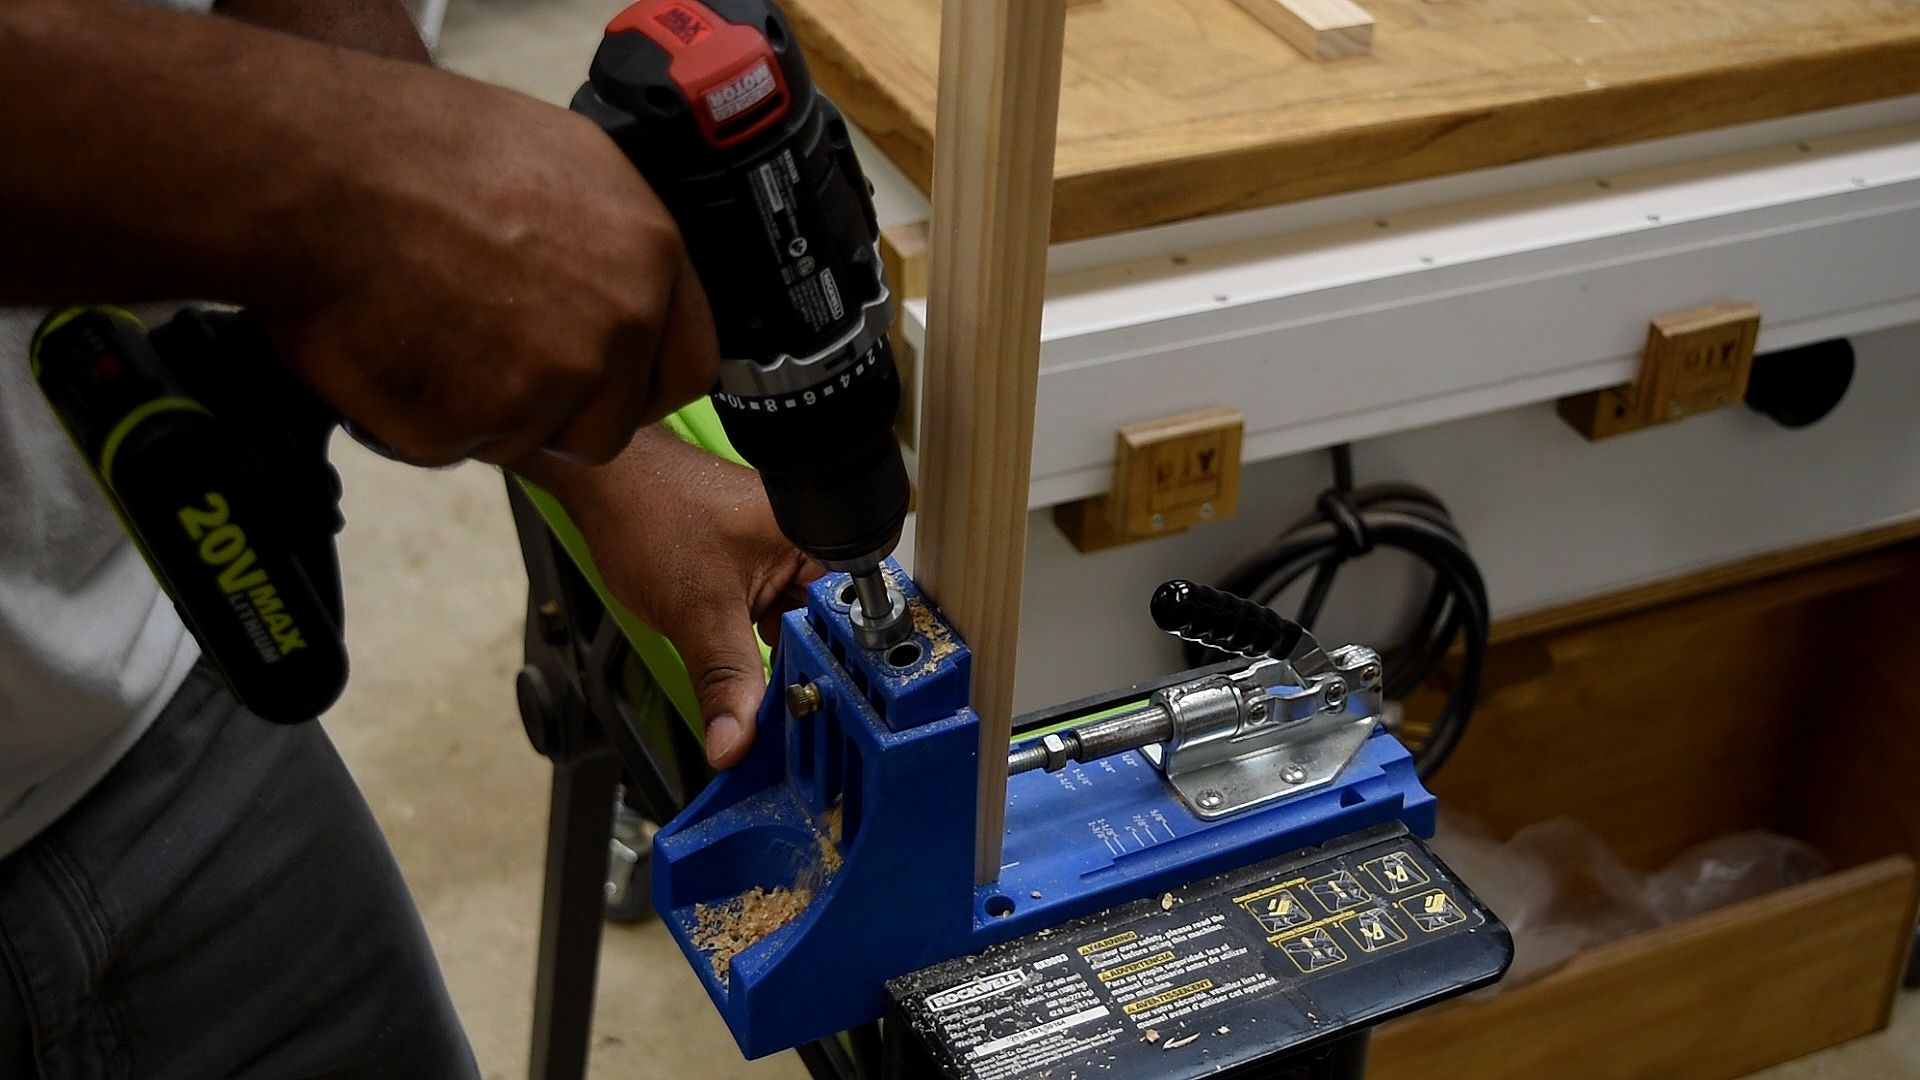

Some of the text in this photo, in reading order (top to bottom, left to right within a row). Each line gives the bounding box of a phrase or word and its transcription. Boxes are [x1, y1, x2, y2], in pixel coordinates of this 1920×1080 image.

[866, 349, 874, 365] 2
[803, 391, 816, 404] 6
[840, 374, 850, 388] 4
[728, 394, 746, 410] 10
[764, 399, 778, 412] 8
[229, 593, 282, 663] LITHIUM
[1118, 942, 1138, 951] own
[1136, 932, 1166, 947] safety,
[1164, 923, 1194, 938] please
[1191, 918, 1211, 928] read
[1210, 913, 1226, 922] the
[1120, 946, 1148, 959] before
[1147, 939, 1172, 952] using
[1170, 934, 1188, 944] this
[1186, 921, 1225, 938] machine.
[1104, 977, 1126, 988] Para
[1219, 943, 1230, 951] el
[1110, 980, 1142, 995] manual
[1141, 976, 1153, 985] de
[1184, 959, 1208, 971] antes
[1207, 955, 1220, 963] de
[1218, 946, 1248, 960] utilizar
[933, 970, 1021, 1007] ROCKWELL
[1129, 1010, 1151, 1021] Pour
[1256, 971, 1267, 980] le
